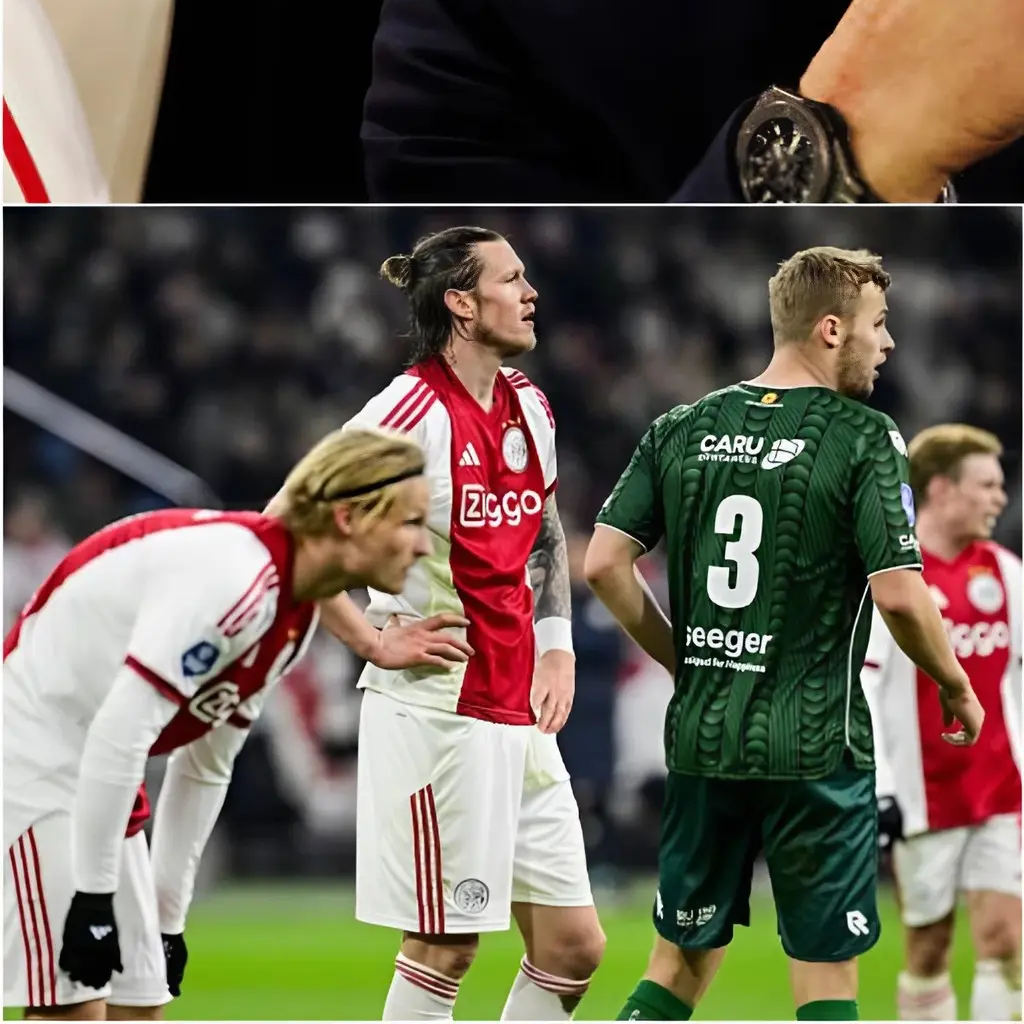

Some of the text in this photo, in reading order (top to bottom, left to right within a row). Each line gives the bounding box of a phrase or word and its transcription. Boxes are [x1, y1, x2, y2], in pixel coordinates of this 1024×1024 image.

[701, 435, 764, 455] CARU
[460, 484, 542, 528] Ziggo
[707, 494, 763, 608] 3
